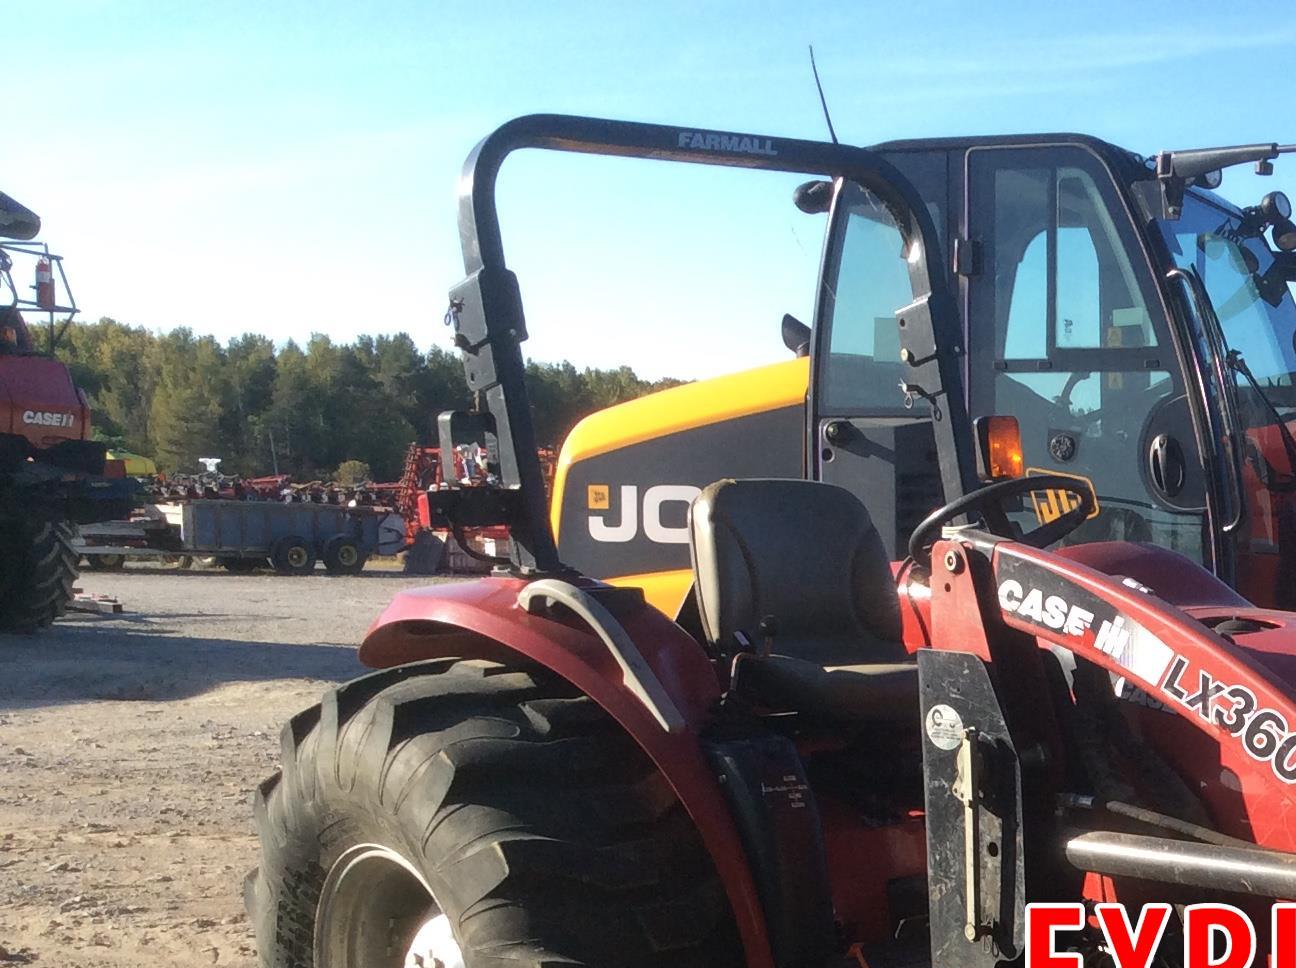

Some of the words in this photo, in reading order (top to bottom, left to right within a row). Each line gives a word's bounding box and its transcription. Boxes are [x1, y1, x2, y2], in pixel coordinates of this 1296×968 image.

[678, 131, 778, 155] FARMALL
[23, 410, 62, 426] CASE
[588, 485, 702, 543] JC
[998, 579, 1095, 637] CASE
